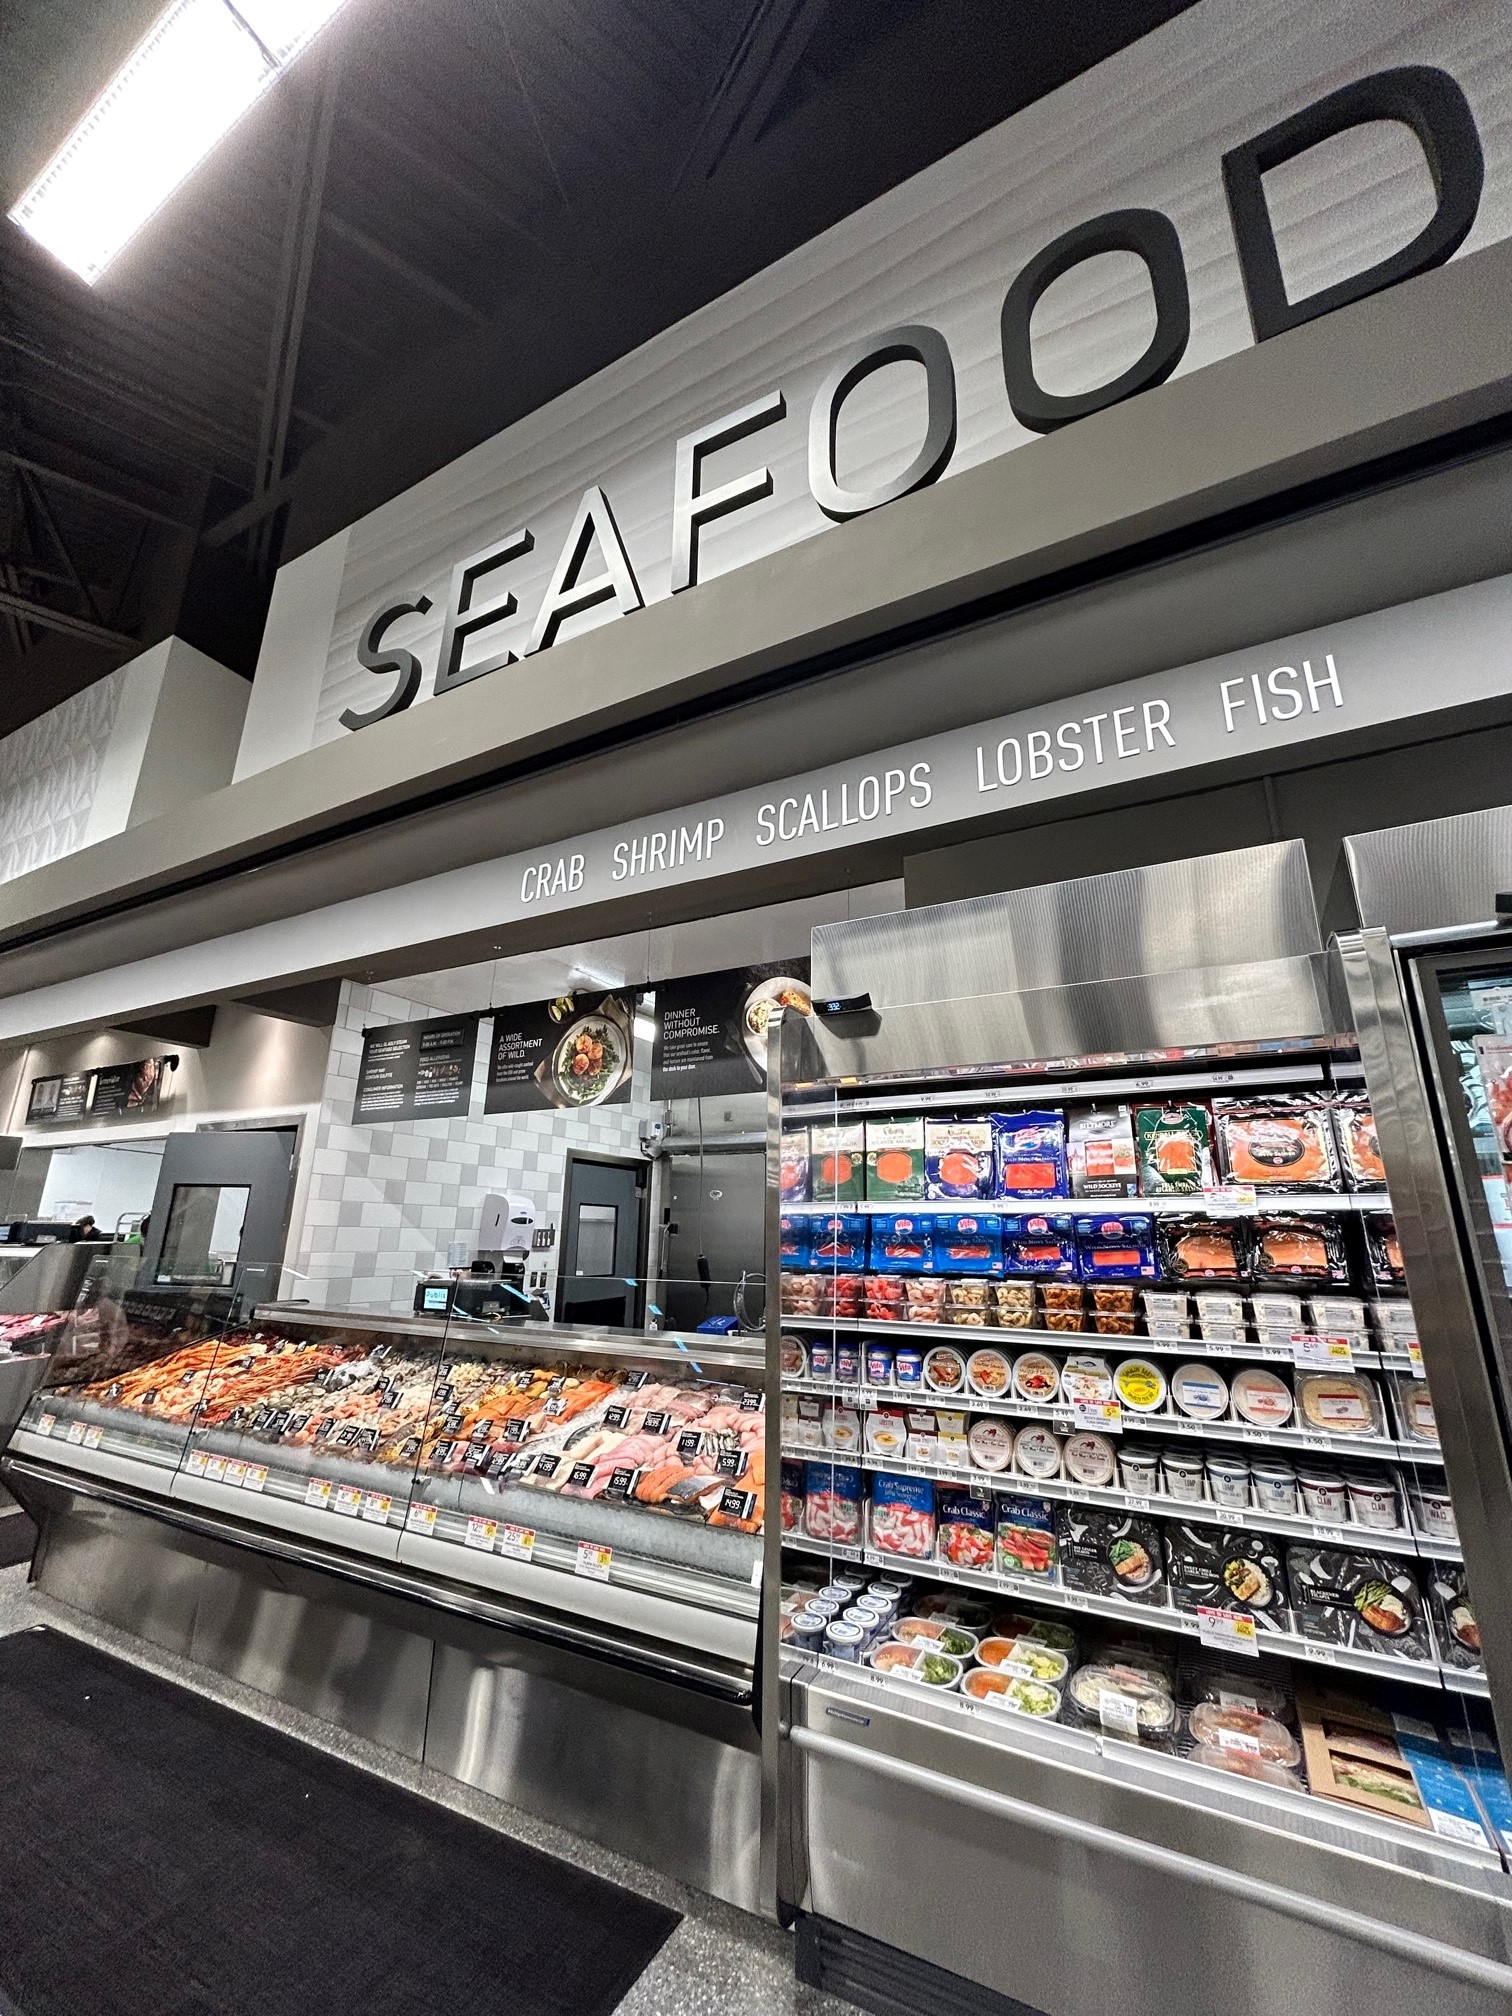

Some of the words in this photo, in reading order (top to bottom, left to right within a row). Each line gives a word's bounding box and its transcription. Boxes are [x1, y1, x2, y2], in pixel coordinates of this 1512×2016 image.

[338, 64, 1485, 732] SEAFOOD
[520, 854, 585, 903] CRAB
[612, 818, 724, 881] SHRIMP
[756, 762, 932, 846] SCALLOPS
[976, 699, 1176, 793] LOBSTER
[1220, 654, 1344, 733] FISH
[665, 1008, 696, 1020] DINNER
[664, 1017, 700, 1030] WITHOUT
[664, 1025, 720, 1040] COMPROMISE.
[506, 1033, 522, 1042] WIDE
[499, 1038, 542, 1051] ASSORTMENT
[498, 1052, 507, 1060] OF
[1079, 1121, 1115, 1130] BILTMORE
[959, 1219, 975, 1228] Vita
[1029, 1219, 1045, 1228] Vita
[870, 1362, 883, 1370] Vita
[899, 1363, 911, 1371] Vita
[722, 1458, 735, 1468] 5.99
[878, 1479, 894, 1490] Crab
[894, 1481, 924, 1494] Supreme
[1222, 1484, 1235, 1492] LUMP
[1317, 1496, 1331, 1506] CLAW
[942, 1504, 960, 1515] Crab
[960, 1507, 985, 1518] Classic
[1371, 1502, 1386, 1511] CLAW
[1001, 1503, 1020, 1515] Crab
[1021, 1507, 1048, 1520] Classic
[1308, 1648, 1326, 1657] 9.99
[821, 1661, 834, 1669] 6.99
